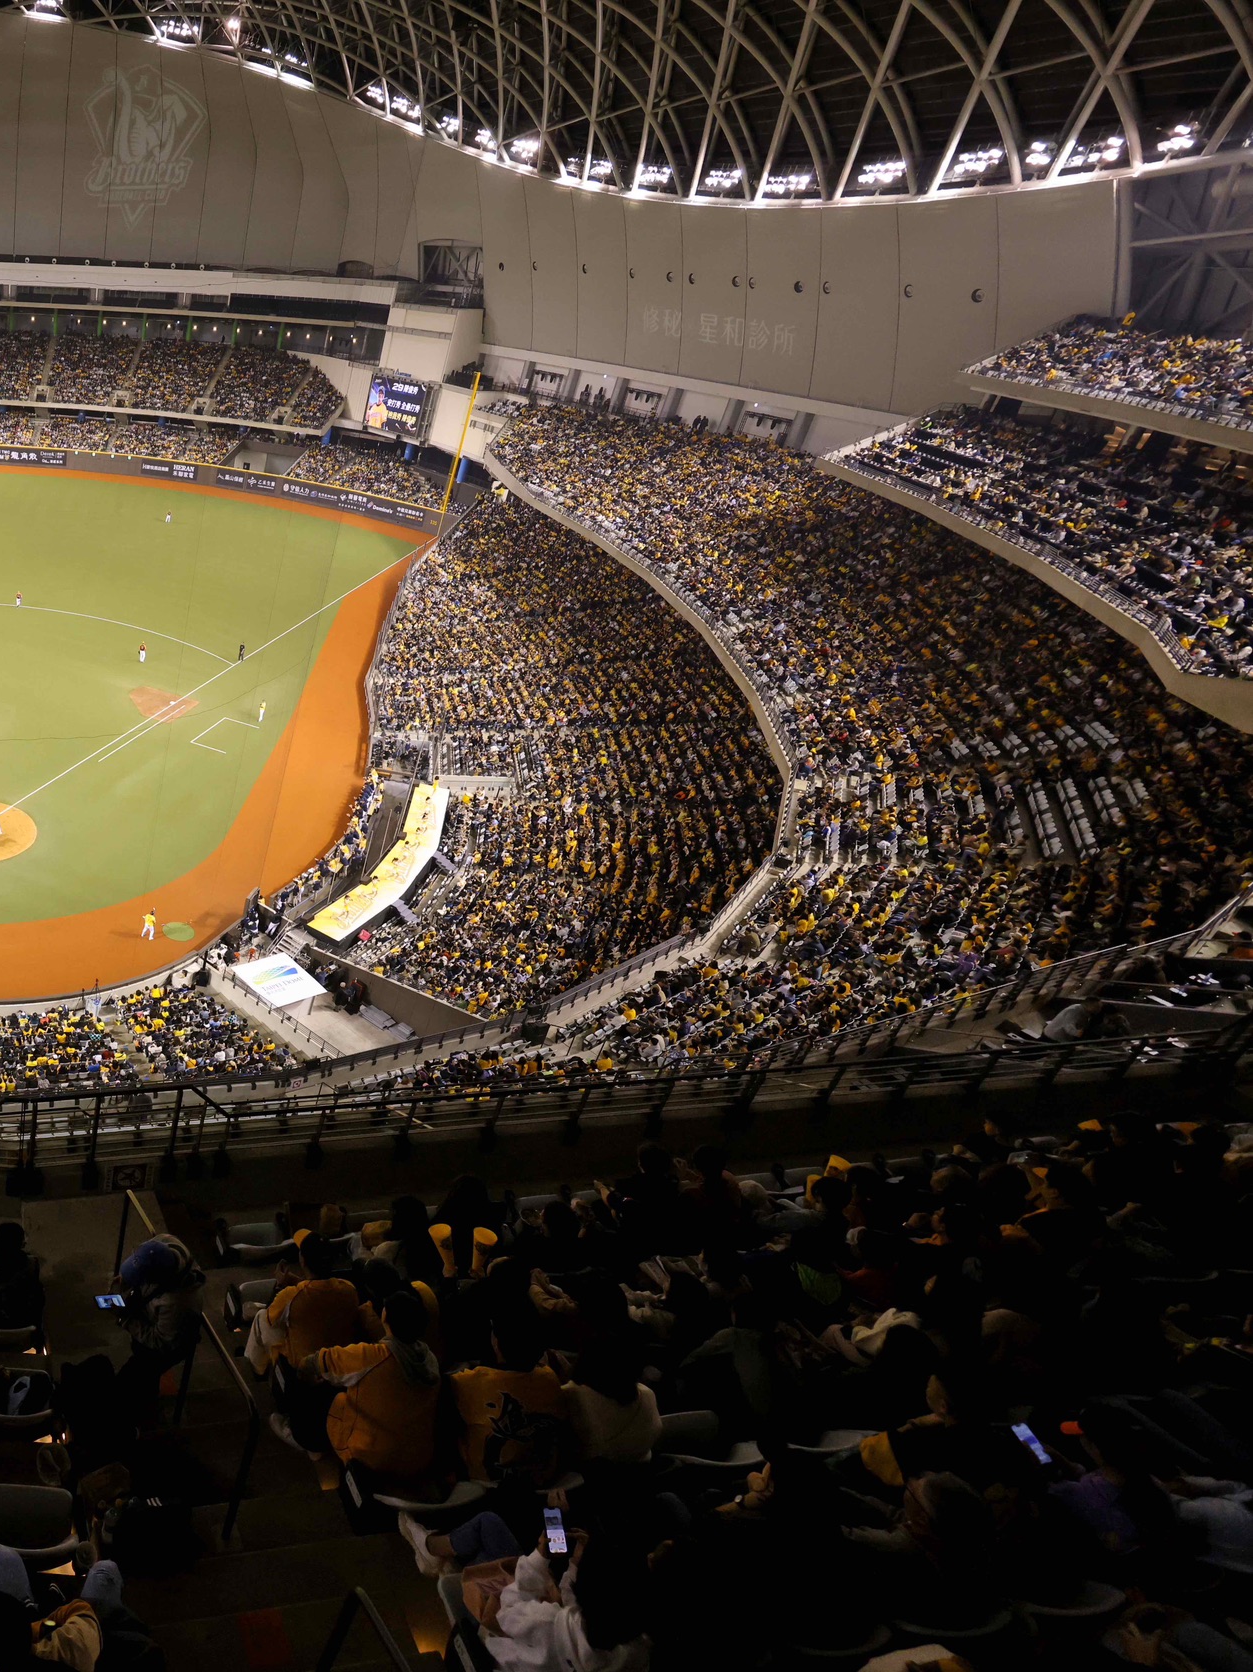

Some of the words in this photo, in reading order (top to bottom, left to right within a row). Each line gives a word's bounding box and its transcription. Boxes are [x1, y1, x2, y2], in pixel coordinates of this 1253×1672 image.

[699, 313, 797, 356] 星和診所
[391, 383, 404, 391] 29
[10, 452, 38, 461] 龍角散
[173, 464, 195, 472] HERAN
[372, 504, 393, 514] Domino's
